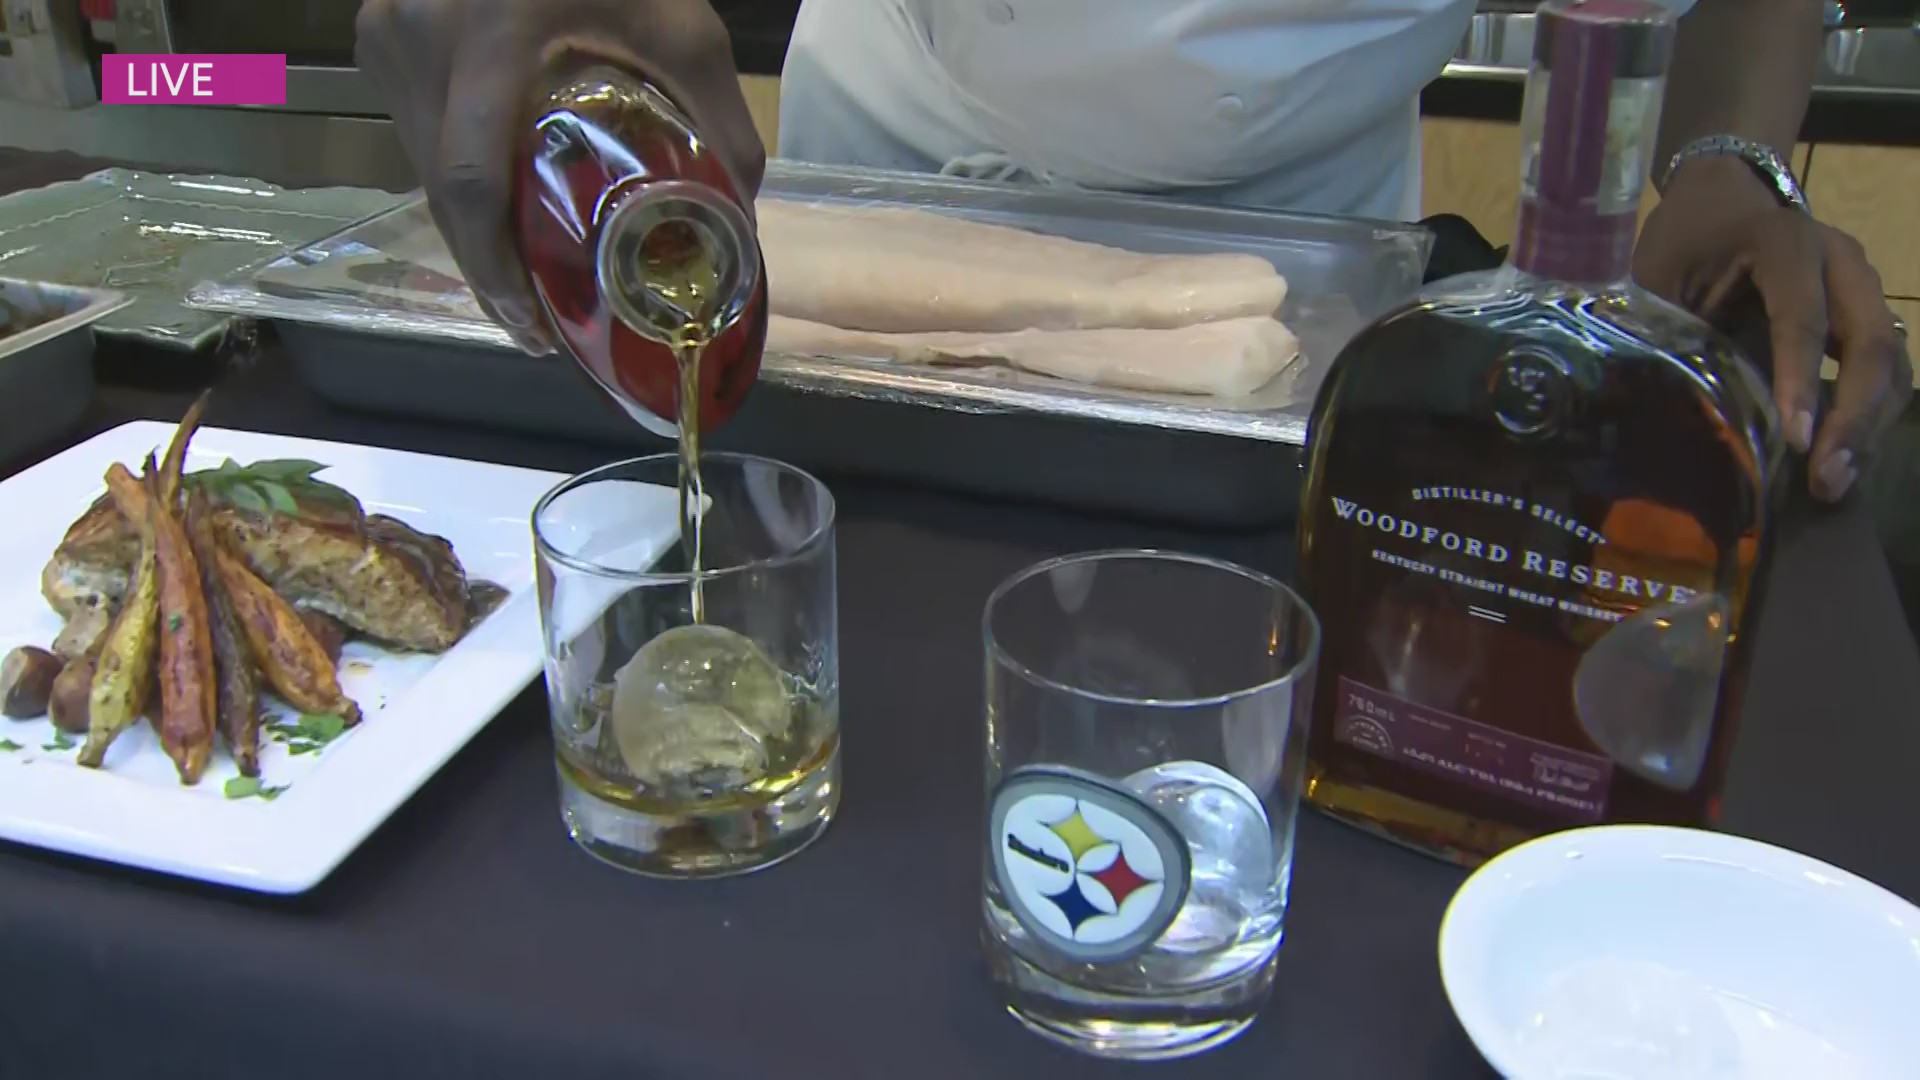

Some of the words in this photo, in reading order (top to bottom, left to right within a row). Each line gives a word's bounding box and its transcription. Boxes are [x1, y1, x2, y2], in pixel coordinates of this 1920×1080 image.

[1412, 487, 1524, 511] DISTILLER'S
[1331, 496, 1509, 562] WOODFORD
[1522, 550, 1693, 604] RESERVE
[1371, 549, 1436, 575] KENTUCKY
[1439, 568, 1504, 594] STRAIGHT
